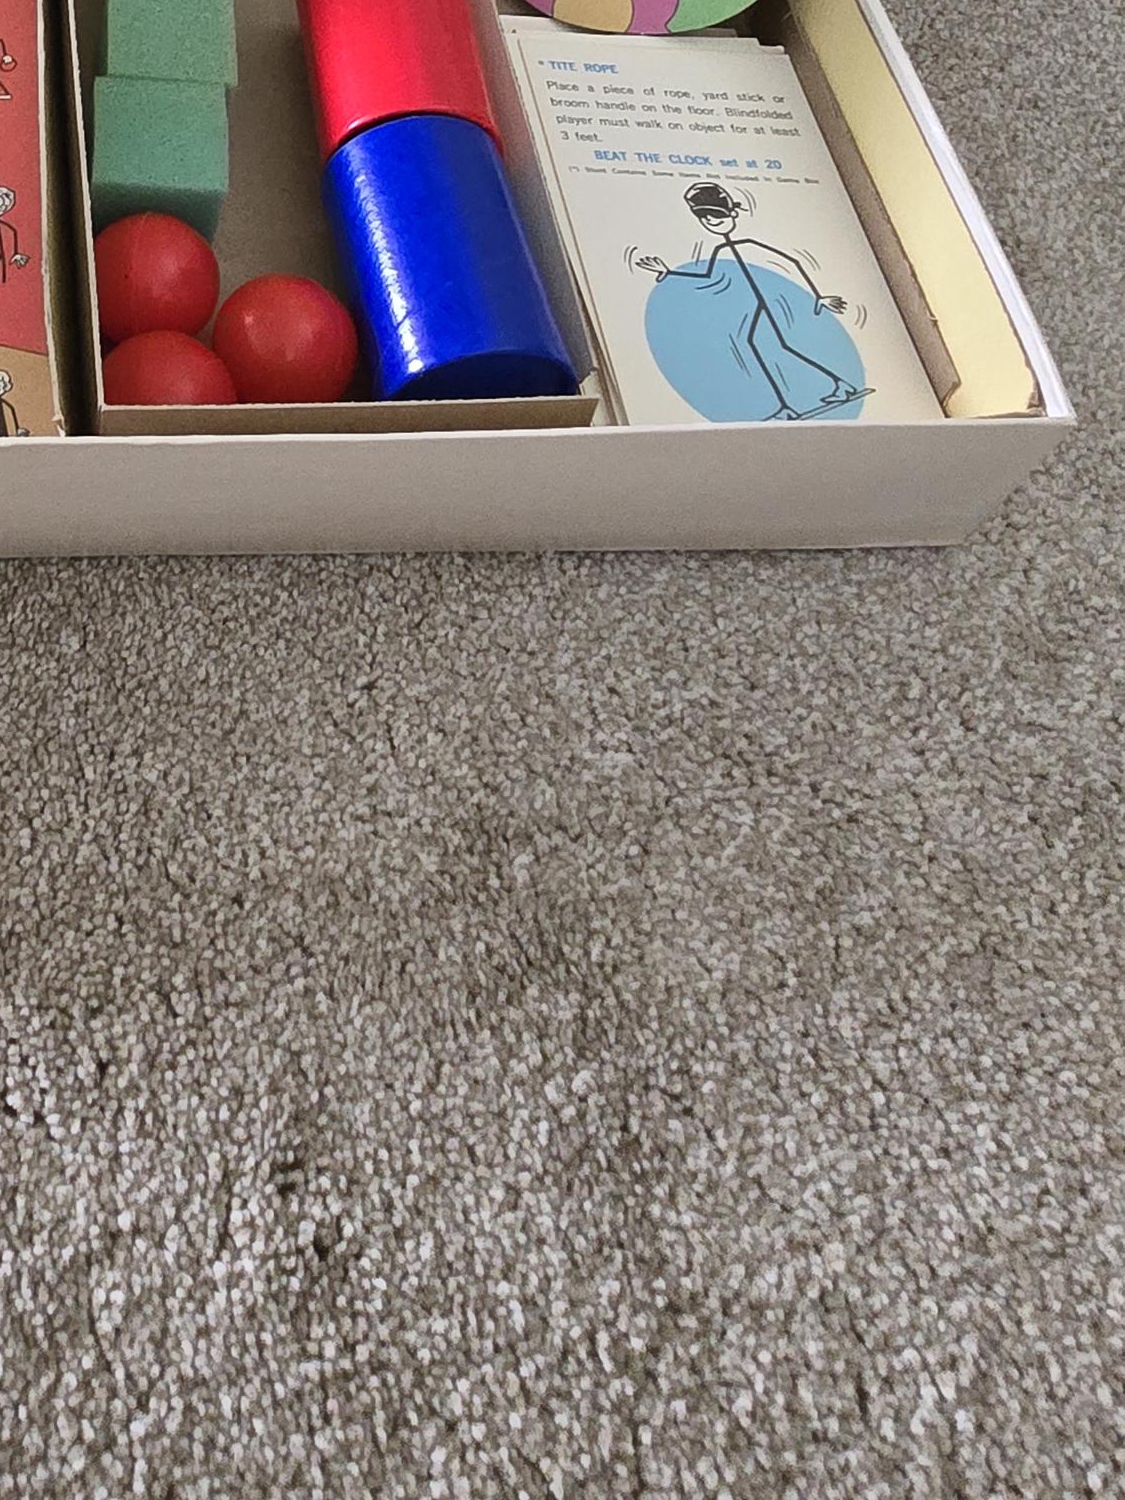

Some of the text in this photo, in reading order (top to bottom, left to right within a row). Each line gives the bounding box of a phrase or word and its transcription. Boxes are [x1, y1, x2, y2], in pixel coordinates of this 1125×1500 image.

[584, 63, 619, 74] ROPE
[547, 80, 785, 103] Place a piece of rope, yard stick or
[550, 97, 589, 108] broom
[595, 100, 635, 111] handle
[641, 104, 657, 112] on
[662, 104, 682, 114] the
[725, 107, 793, 120] Blindfolded
[556, 115, 801, 137] player must walk on object for at least
[560, 131, 569, 141] 3
[594, 150, 782, 169] BEAT THE CLOCK set at 20
